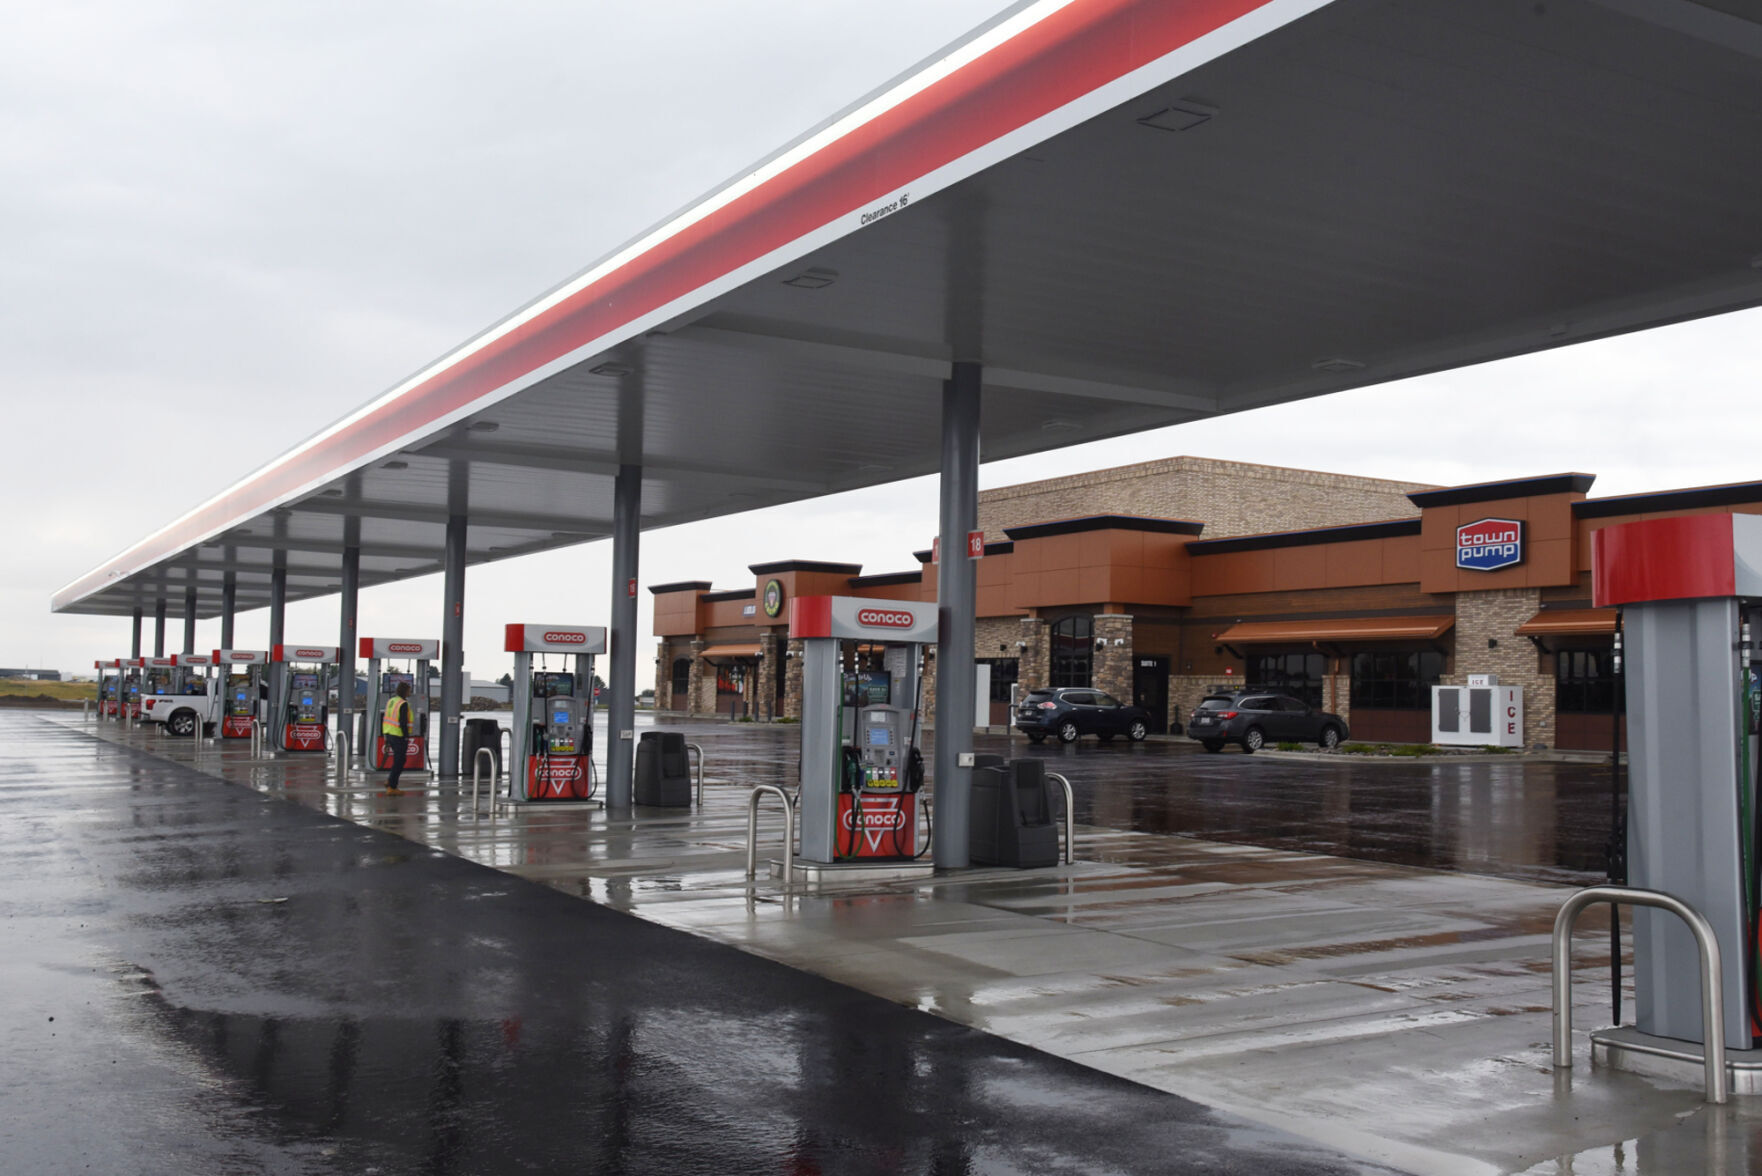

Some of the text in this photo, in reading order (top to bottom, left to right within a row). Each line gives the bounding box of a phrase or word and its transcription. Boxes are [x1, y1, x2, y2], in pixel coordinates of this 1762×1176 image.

[861, 201, 898, 225] Clearance
[971, 537, 982, 552] 18
[1460, 531, 1515, 546] town
[1461, 544, 1515, 561] pump
[861, 612, 911, 625] conoco
[546, 633, 584, 642] conoco
[1507, 690, 1516, 734] ICE
